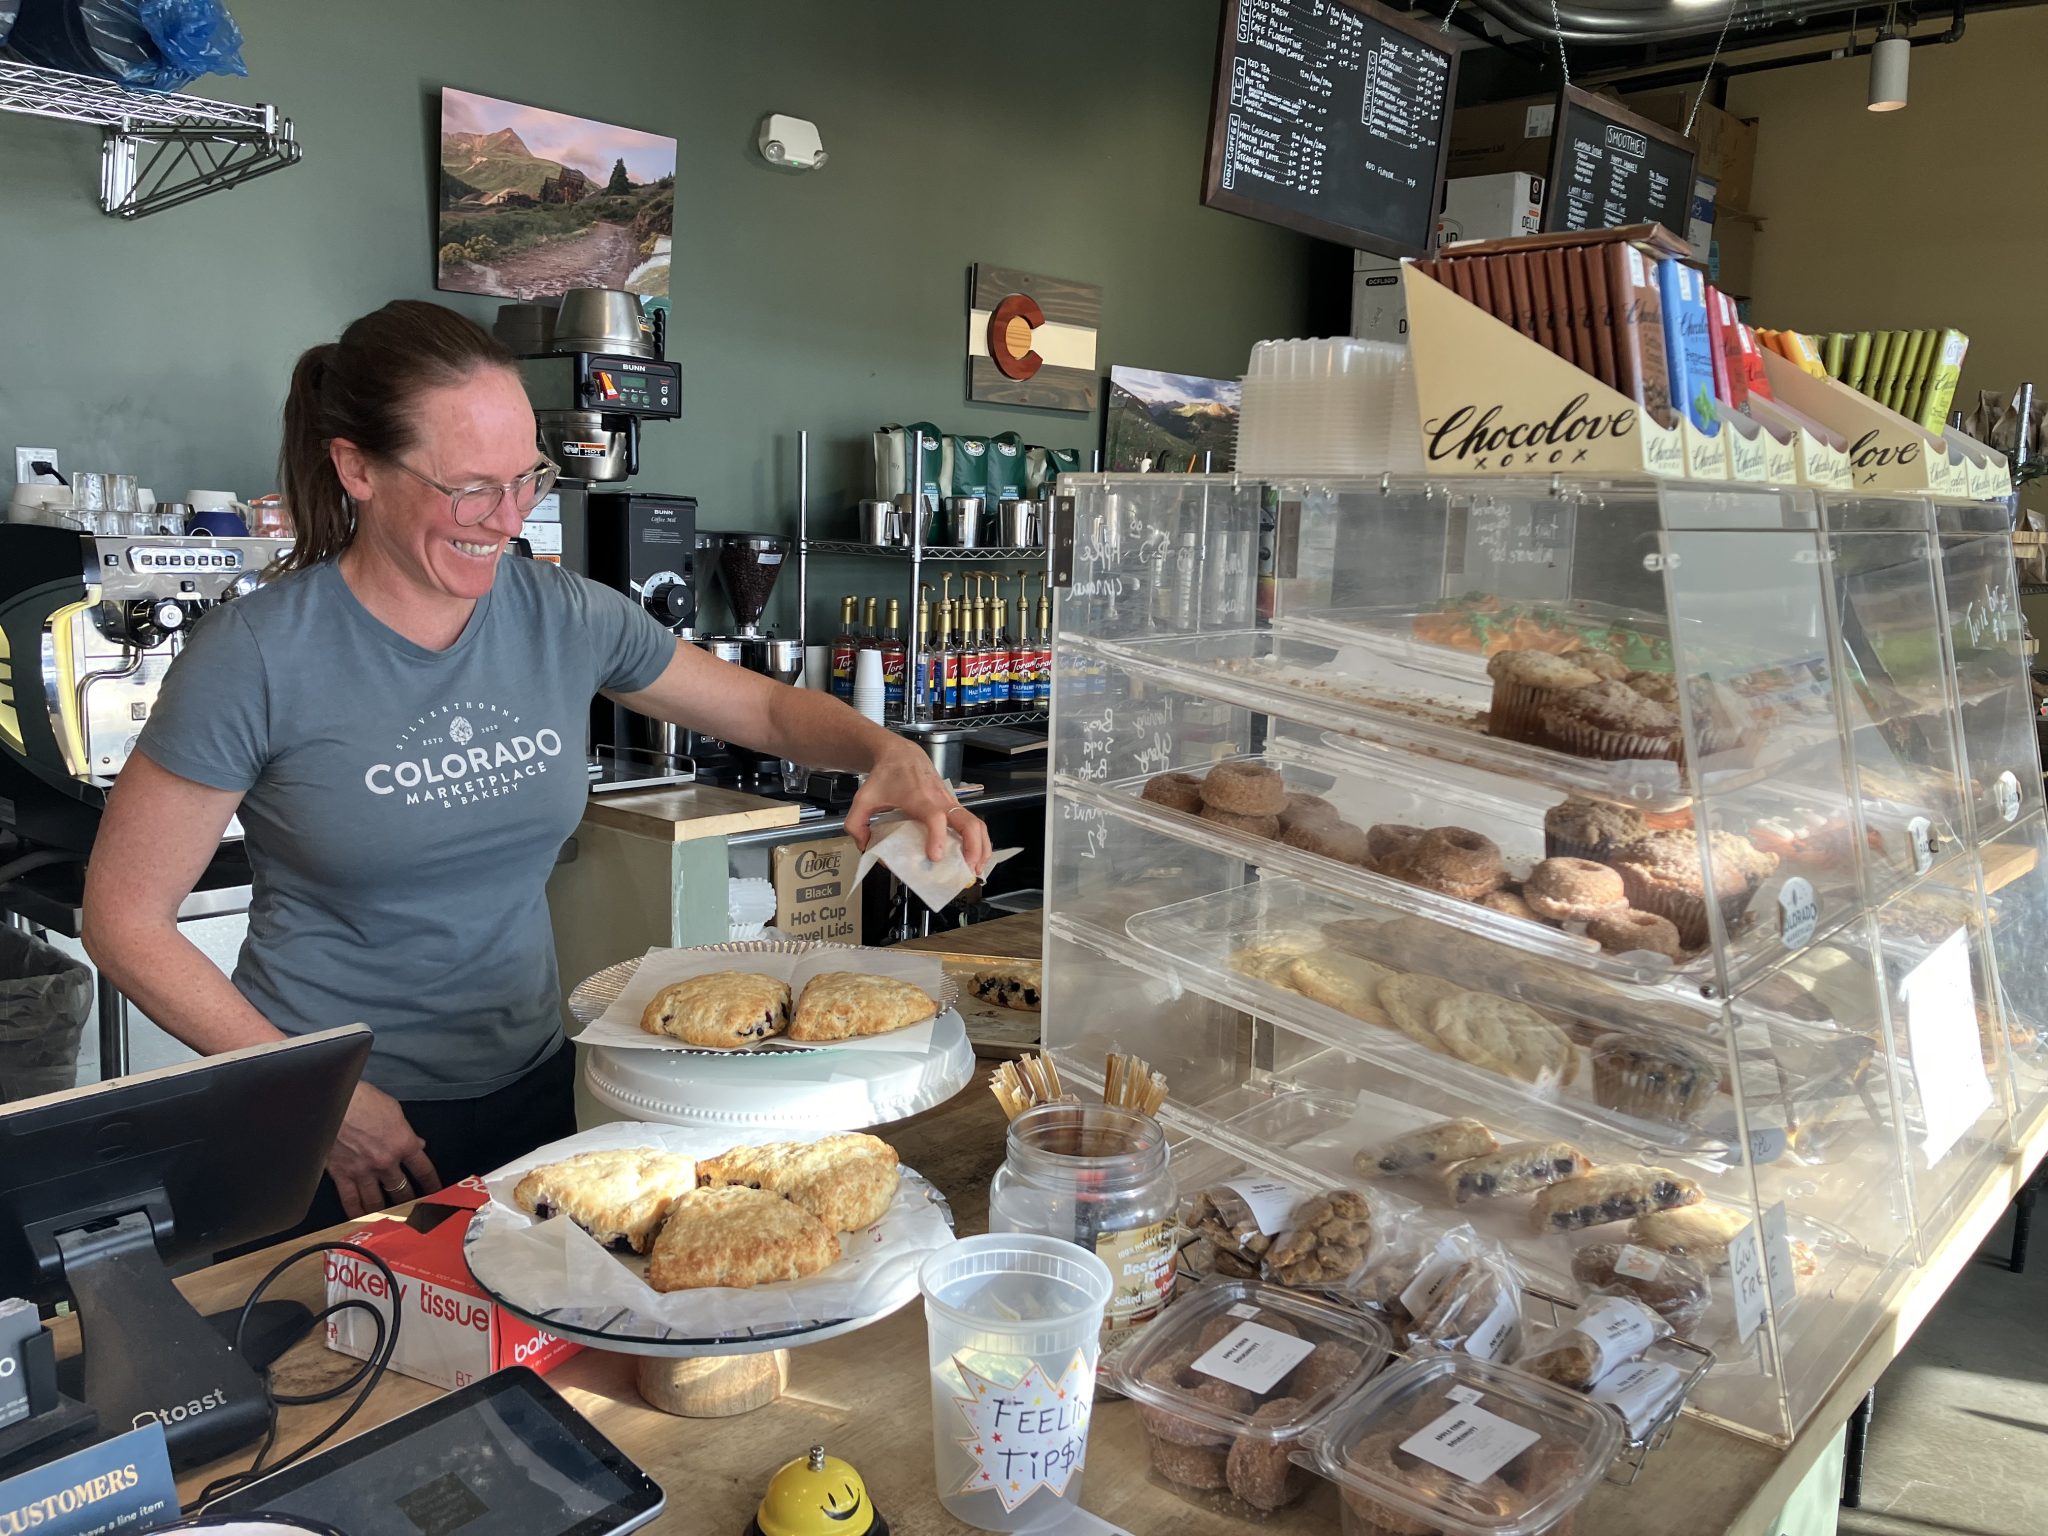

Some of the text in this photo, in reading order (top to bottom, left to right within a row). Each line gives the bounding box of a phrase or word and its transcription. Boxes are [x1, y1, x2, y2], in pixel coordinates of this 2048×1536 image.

[1253, 0, 1289, 17] COLD BREW
[1252, 8, 1294, 34] CAFE AU LAIT
[1251, 20, 1266, 34] CAFE
[1268, 28, 1302, 49] FLORENTINE
[1256, 36, 1274, 51] GALLON
[1286, 48, 1305, 62] COFFEE
[1381, 48, 1395, 59] LATTE
[1248, 58, 1270, 74] ICED TEA
[1234, 66, 1245, 100] TEA
[1246, 76, 1265, 90] HOT TEA
[1377, 78, 1401, 94] AMERICANO
[1240, 120, 1251, 131] HOT
[1251, 124, 1281, 143] CHOCOLATE
[1240, 131, 1258, 145] MATCHA
[1260, 140, 1275, 151] LATTE
[1608, 128, 1645, 155] SMOOTHIES
[1237, 150, 1260, 166] STEAMER
[1238, 140, 1251, 153] SPICY
[1266, 151, 1280, 162] LATTE
[1366, 160, 1376, 171] ADD
[1378, 166, 1394, 180] FLAVOR
[622, 364, 646, 372] BUNN
[1424, 392, 1636, 461] Chocolove
[651, 516, 666, 524] Coffee
[1012, 658, 1035, 676] Toran
[396, 702, 521, 751] SILVERTHORNE
[423, 724, 499, 746] ESTD 2020
[365, 728, 562, 795] COLORADO
[406, 761, 547, 805] MARKETPLACE
[444, 783, 519, 809] & BAKERY
[795, 850, 841, 880] CHOICE
[805, 886, 833, 899] Black
[791, 906, 847, 926] Hot Cup
[792, 922, 854, 941] avel Lids
[1123, 1260, 1149, 1277] Bee
[1114, 1282, 1162, 1307] Salted Honey
[420, 1283, 489, 1332] tissue
[159, 1388, 228, 1426] toast
[0, 1464, 139, 1536] CUSTOMERS
[108, 1520, 116, 1530] a
[117, 1512, 137, 1526] line
[140, 1500, 165, 1516] item
